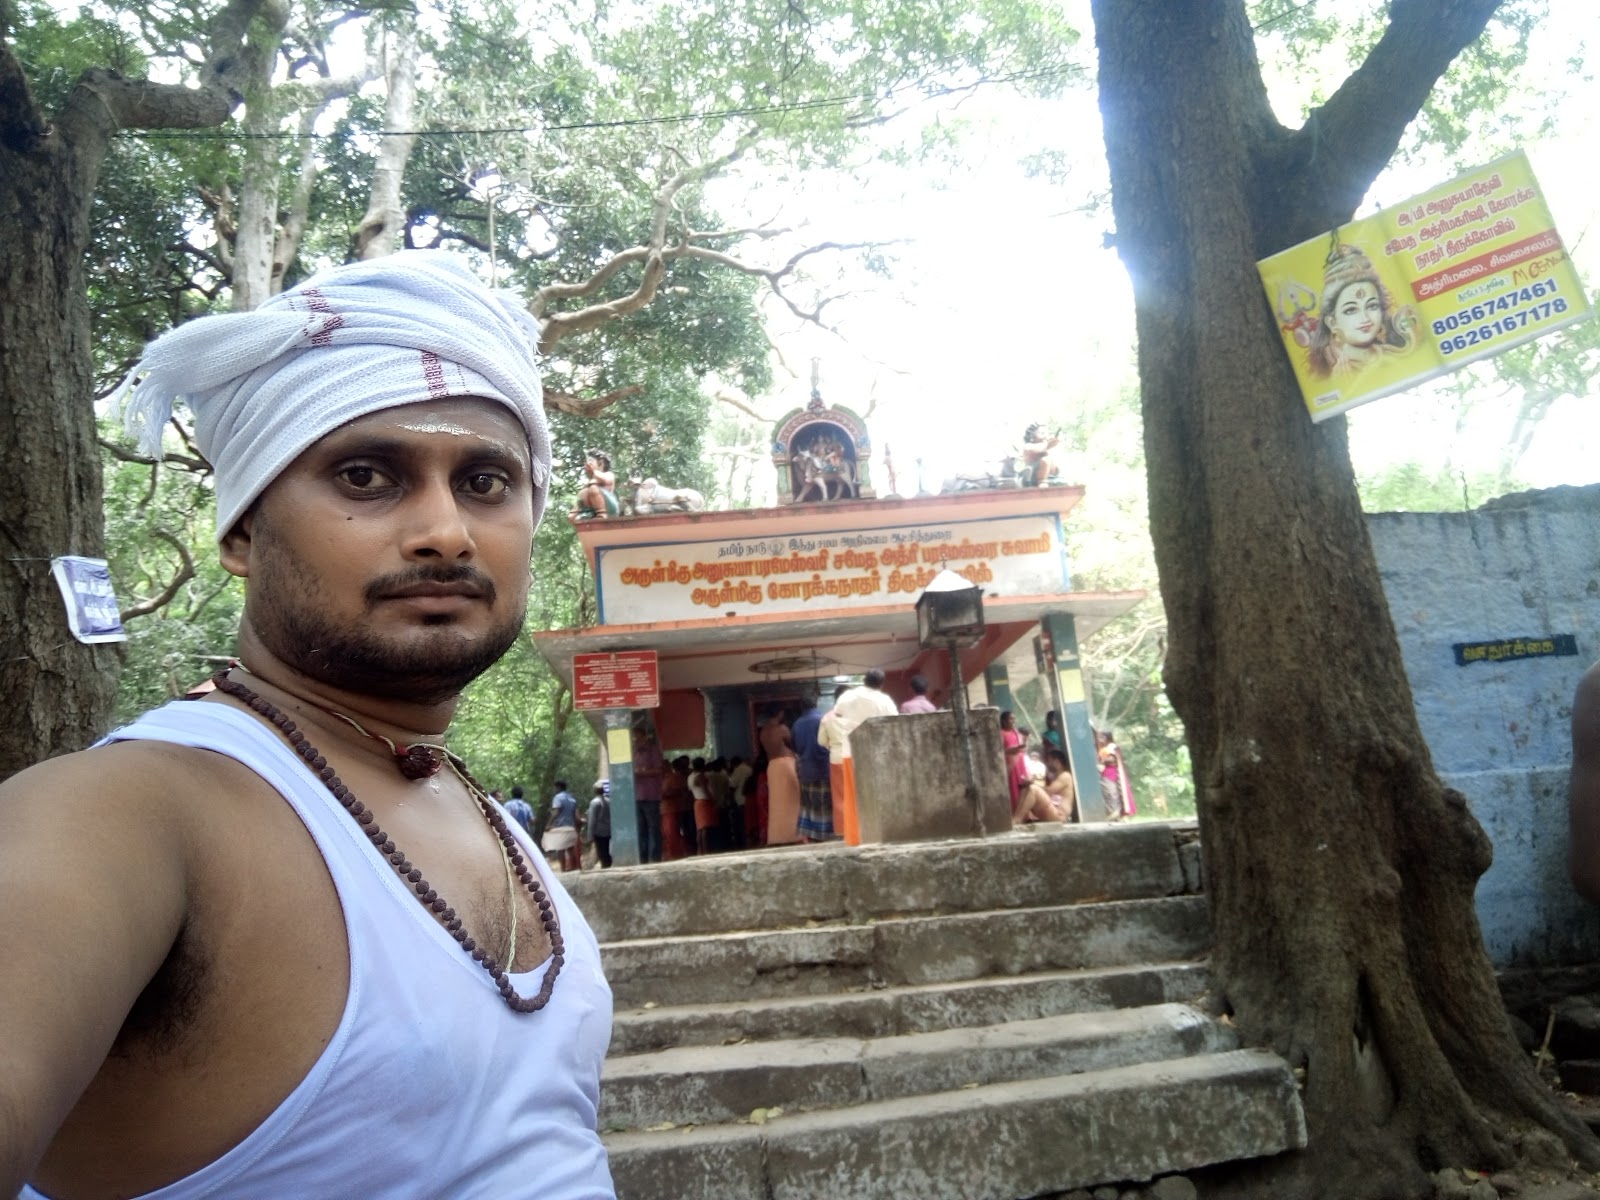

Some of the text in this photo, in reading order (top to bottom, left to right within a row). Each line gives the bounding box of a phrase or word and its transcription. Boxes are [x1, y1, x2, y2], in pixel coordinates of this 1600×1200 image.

[1385, 235, 1417, 255] சமேத
[1415, 217, 1516, 270] நாதர் திருக்கோவில்
[1432, 278, 1557, 336] 8056747461
[1440, 298, 1568, 355] 9626167178
[833, 549, 878, 572] சமேத
[880, 542, 919, 568] அத்ரி
[1001, 531, 1051, 556] சுவாமி
[767, 569, 881, 602] கோரக்கநாதர்
